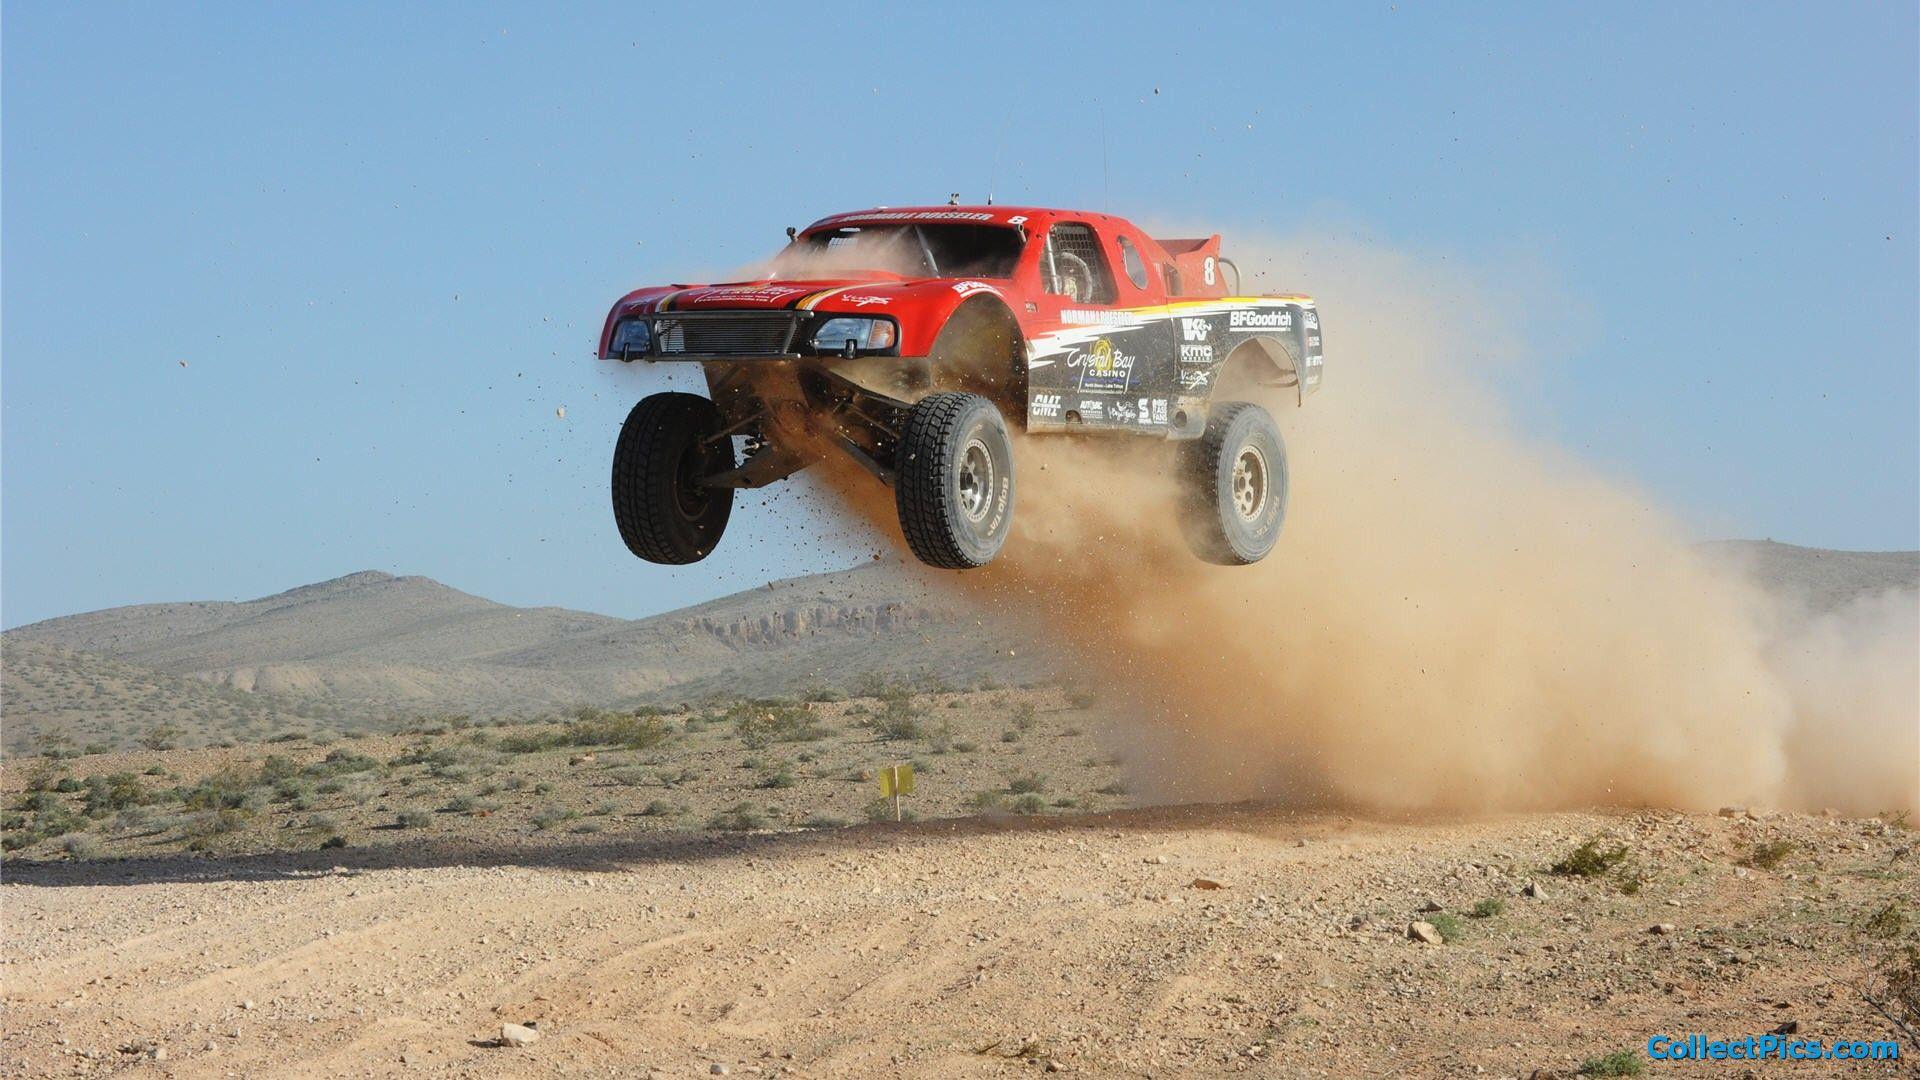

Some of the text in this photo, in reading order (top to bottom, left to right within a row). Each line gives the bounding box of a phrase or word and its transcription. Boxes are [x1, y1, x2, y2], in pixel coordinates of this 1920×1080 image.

[1007, 216, 1028, 226] 8
[1203, 256, 1217, 287] 8
[1229, 311, 1292, 328] BFGoodrich
[1066, 347, 1136, 370] Crystal Bay
[1089, 369, 1126, 378] CASINO
[998, 477, 1009, 513] Baja
